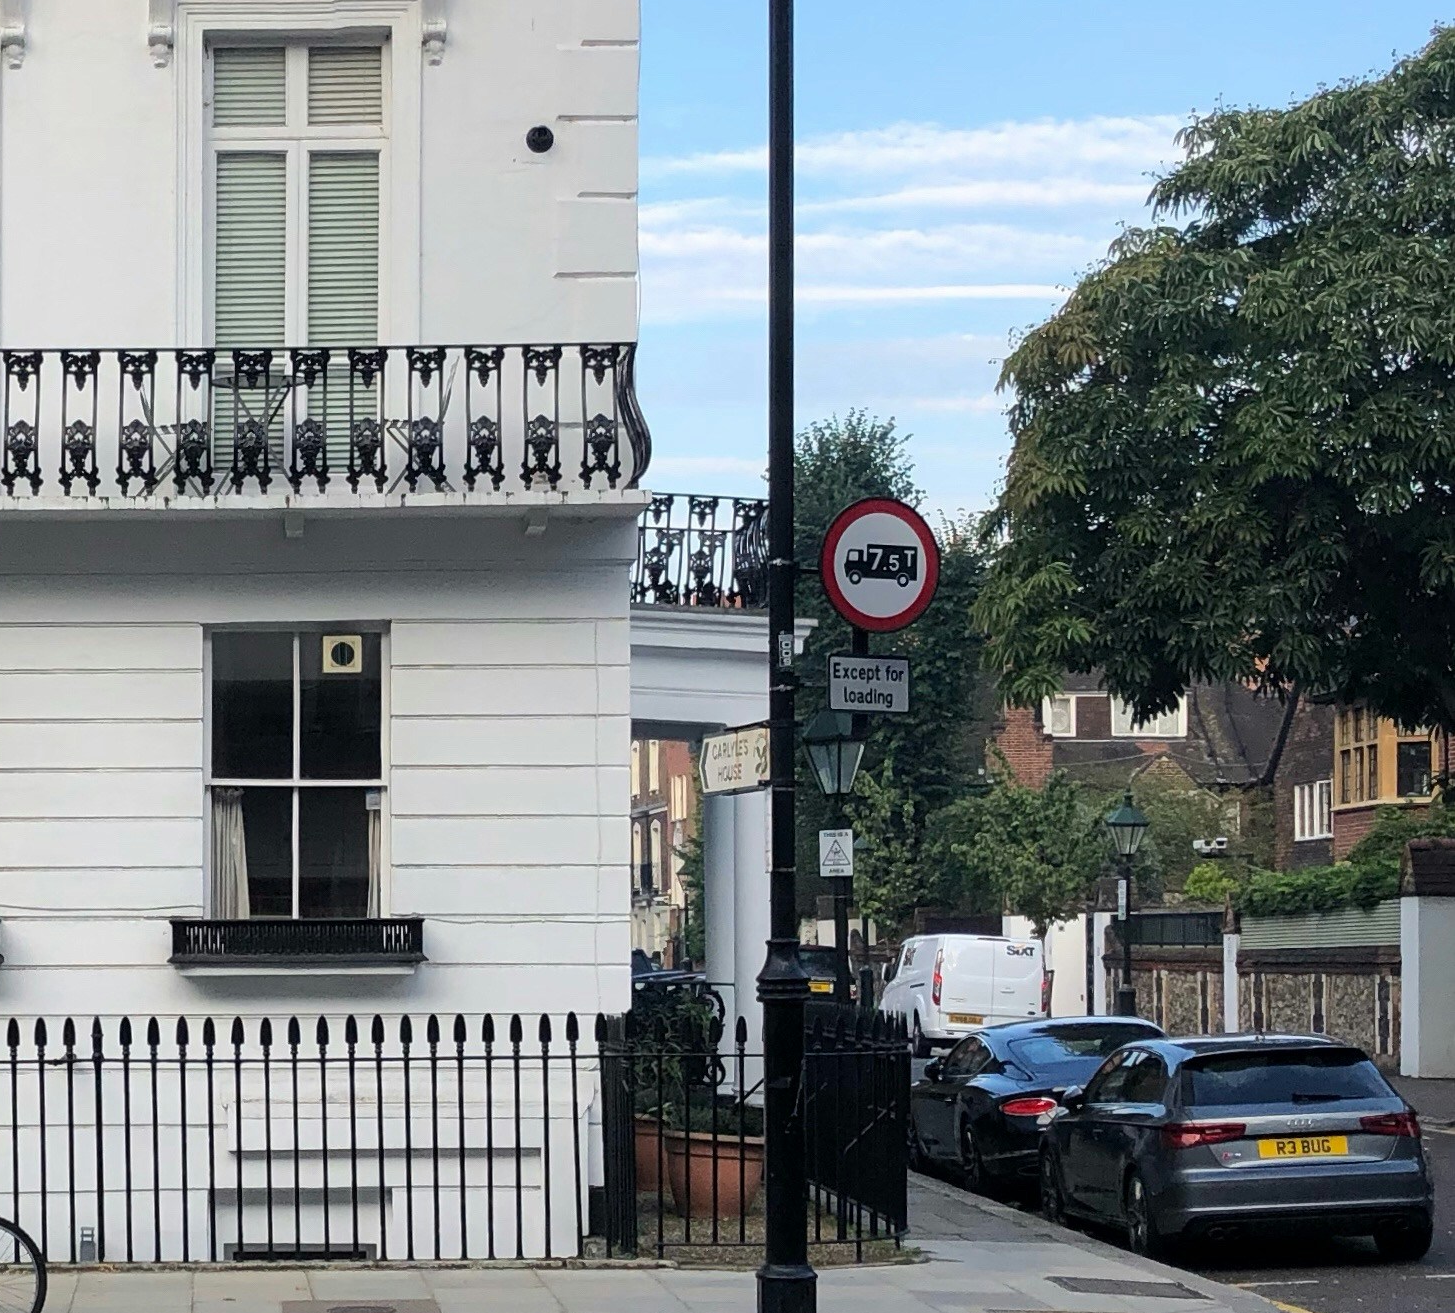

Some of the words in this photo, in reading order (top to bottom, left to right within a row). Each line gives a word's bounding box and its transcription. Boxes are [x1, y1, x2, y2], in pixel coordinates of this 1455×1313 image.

[833, 662, 881, 684] Except
[886, 665, 904, 682] for
[843, 687, 893, 708] loading
[718, 763, 742, 783] HOUSE
[1276, 1141, 1297, 1155] R3
[1301, 1139, 1331, 1153] BUG
